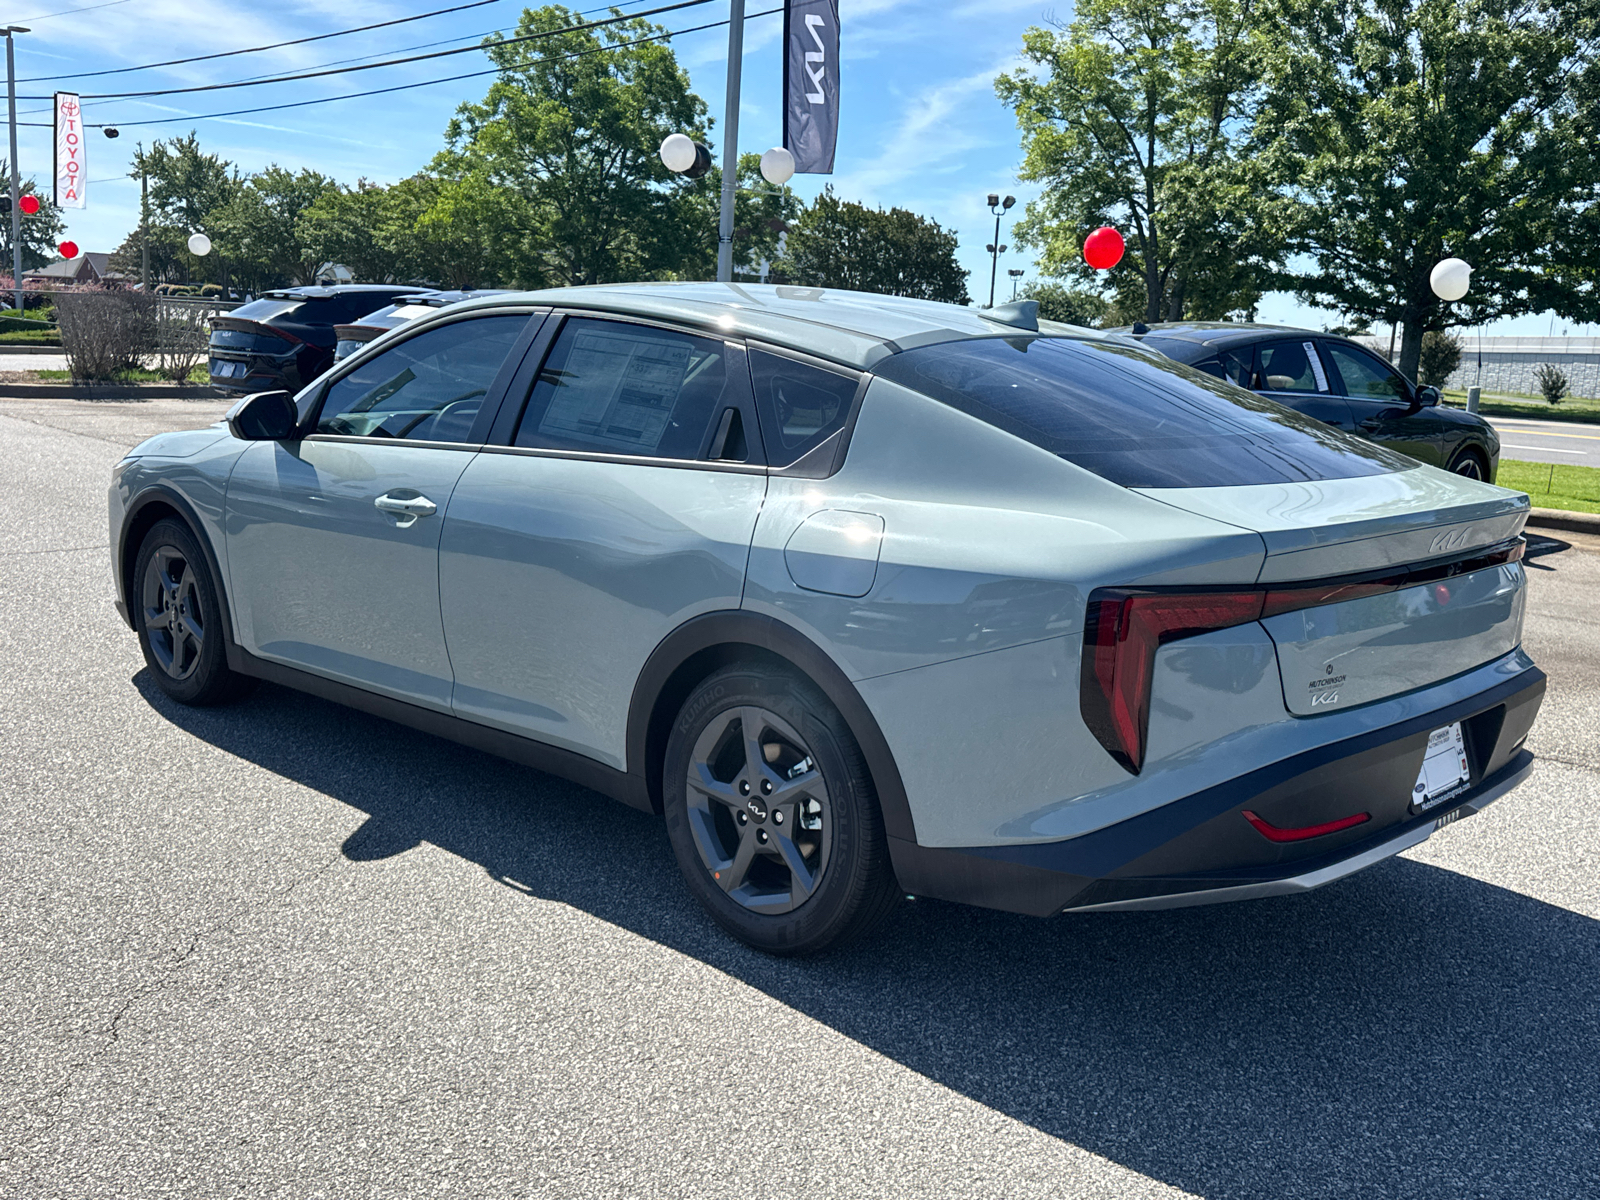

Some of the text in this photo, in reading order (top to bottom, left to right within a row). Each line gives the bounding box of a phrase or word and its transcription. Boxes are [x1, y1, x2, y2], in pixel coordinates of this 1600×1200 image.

[805, 14, 825, 105] KIA
[65, 119, 79, 201] TOYOTA
[1428, 526, 1472, 553] KIA
[1308, 674, 1347, 689] HUTCHINSON
[1311, 690, 1339, 706] K4
[679, 685, 725, 734] KUMHO
[748, 801, 766, 818] KIA
[835, 780, 848, 866] SOLUS
